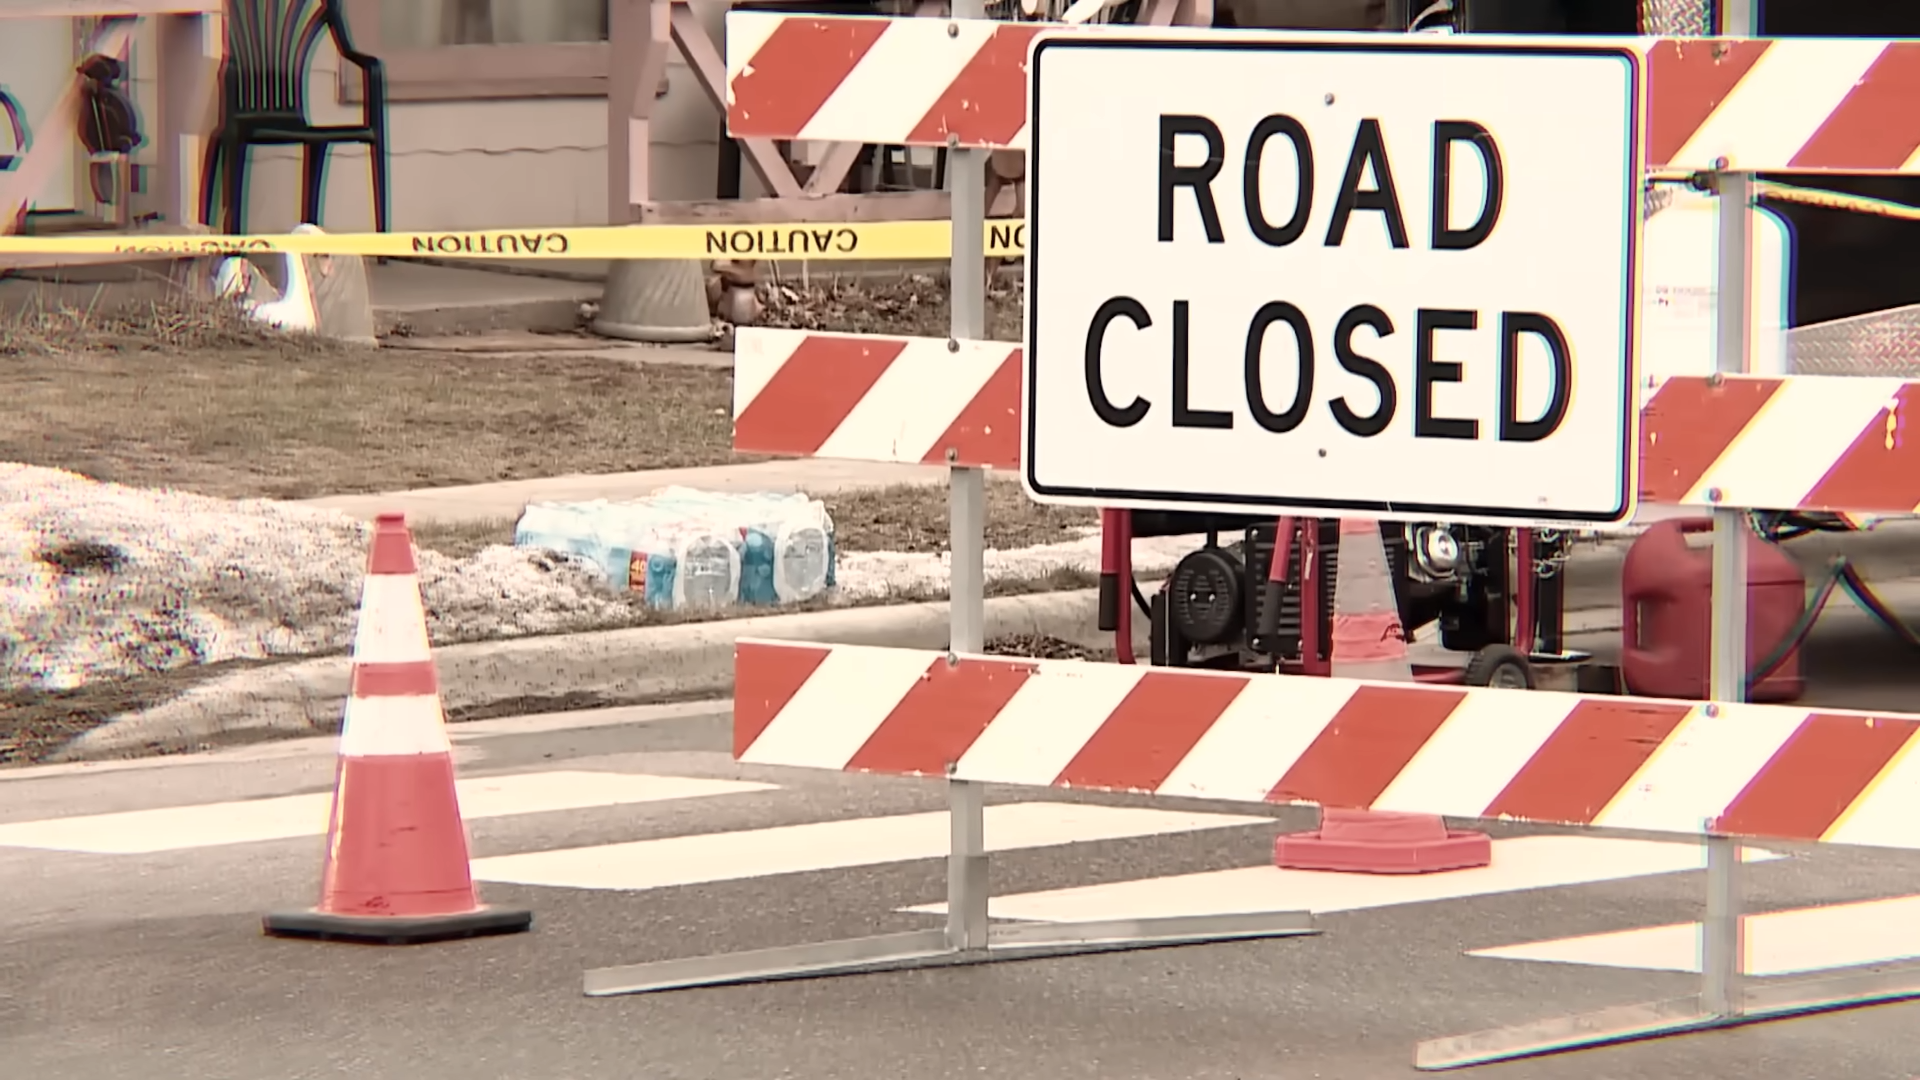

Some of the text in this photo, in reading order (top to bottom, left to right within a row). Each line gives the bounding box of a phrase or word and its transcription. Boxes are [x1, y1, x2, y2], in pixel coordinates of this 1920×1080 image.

[1157, 113, 1505, 250] ROAD
[412, 233, 568, 253] CAUTION
[706, 229, 858, 253] CAUTION
[1085, 296, 1574, 442] CLOSED
